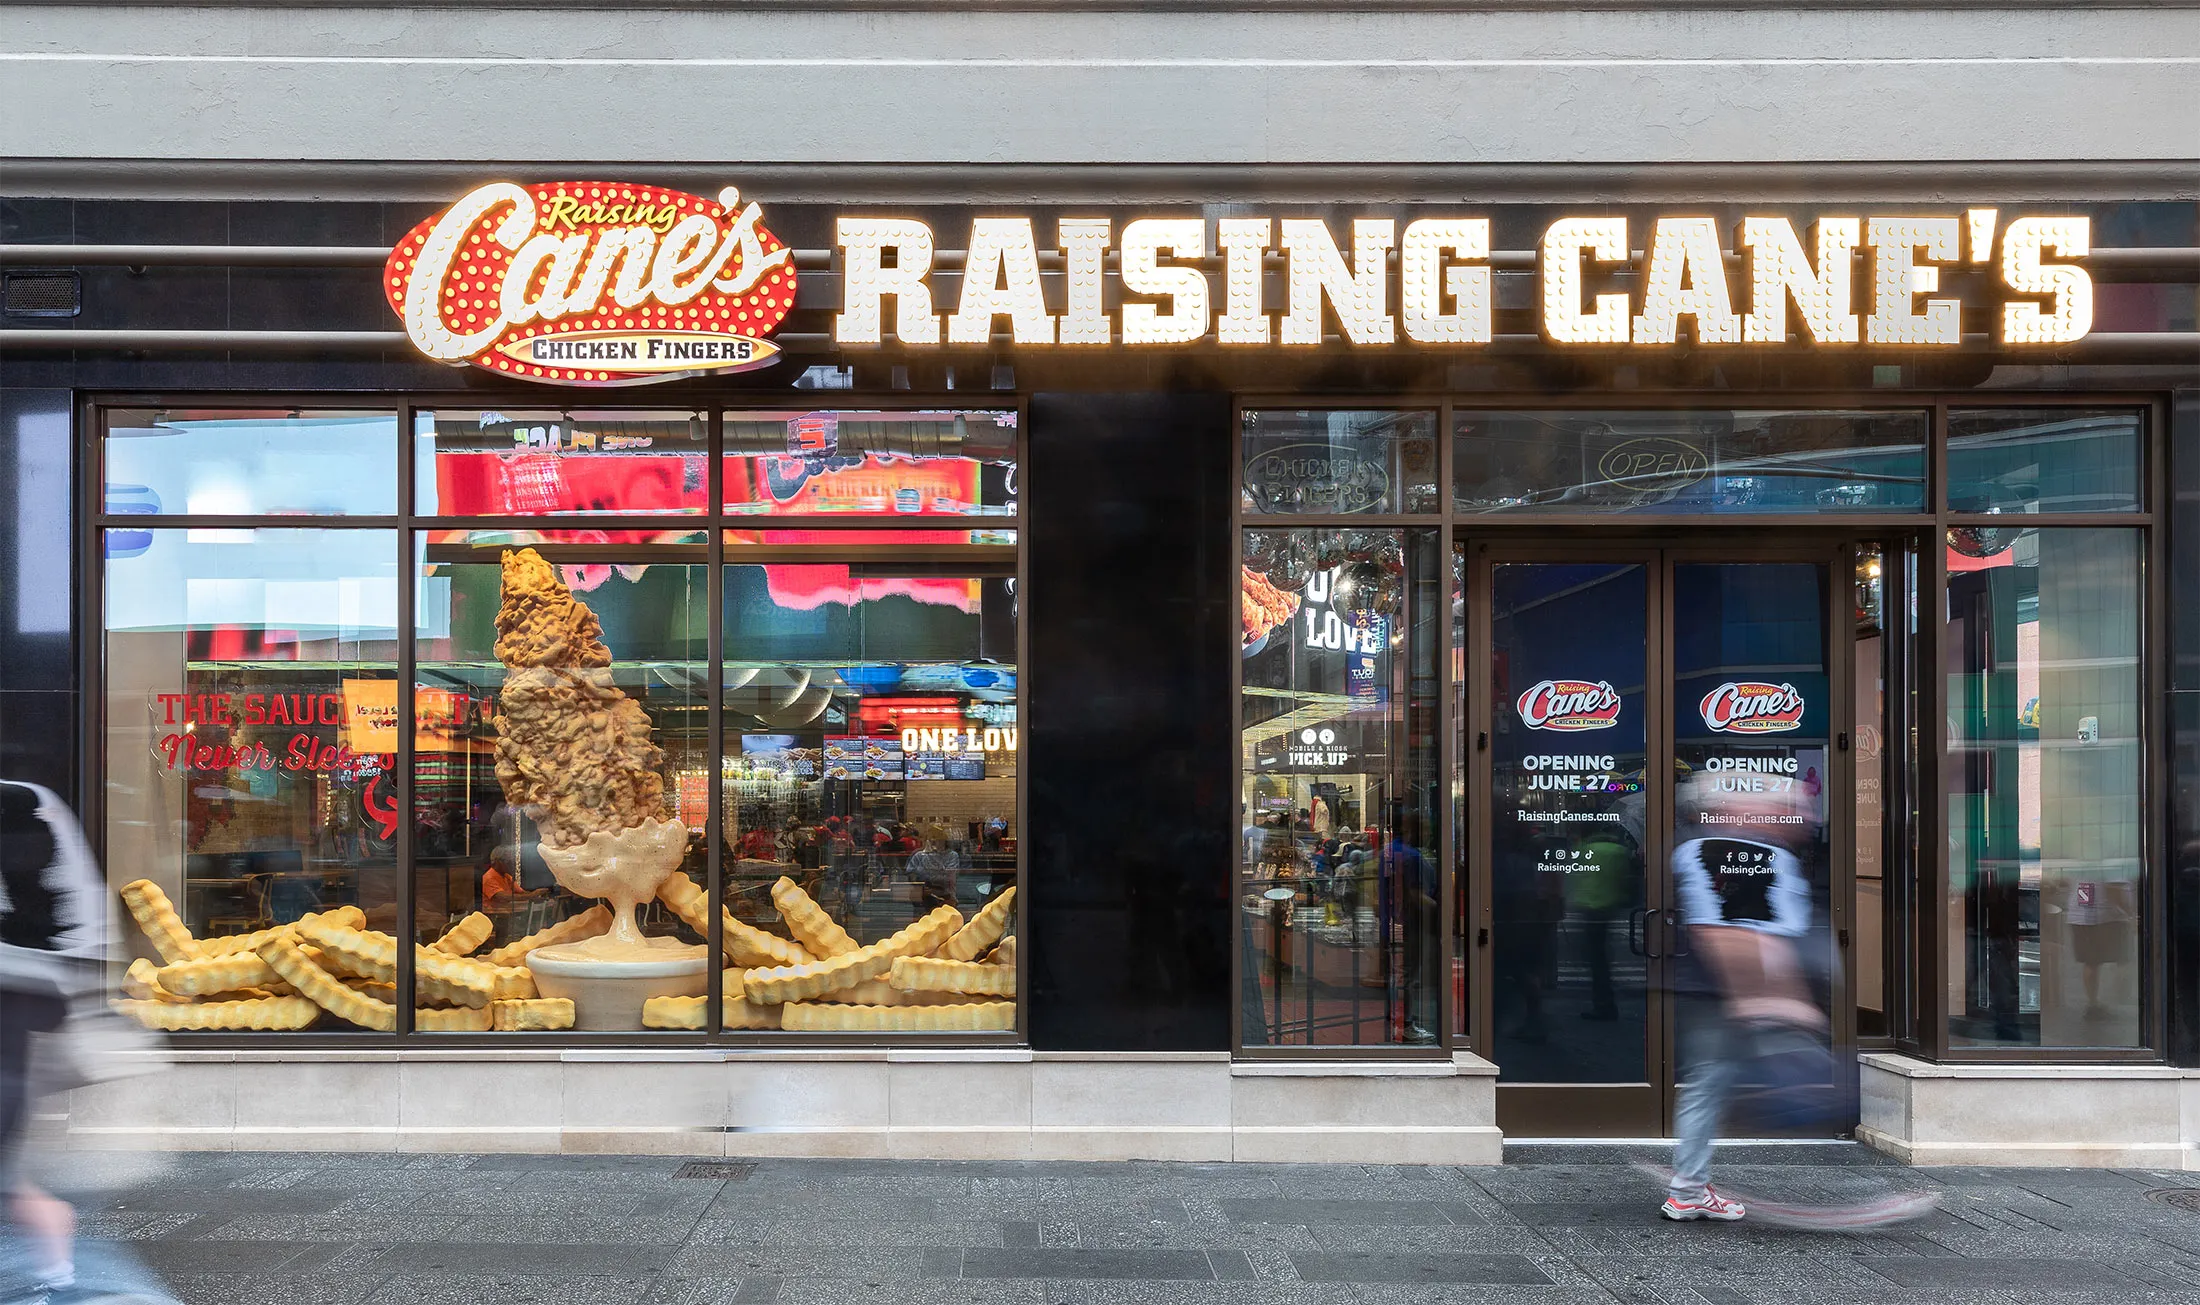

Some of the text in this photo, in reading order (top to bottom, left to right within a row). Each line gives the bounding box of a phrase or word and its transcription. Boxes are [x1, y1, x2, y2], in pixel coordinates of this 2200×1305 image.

[545, 195, 677, 233] Raising
[403, 181, 791, 360] Cane's
[836, 208, 2094, 344] RAISING CANE'S
[532, 338, 751, 360] CHICKEN FINGERS
[1266, 456, 1369, 479] CHICKEN
[1609, 452, 1697, 479] OPEN
[1266, 482, 1365, 503] FINGERS
[1305, 607, 1377, 654] LOVE
[1557, 684, 1590, 694] Raising
[1740, 686, 1773, 696] Raising
[157, 693, 232, 725] THE
[1523, 680, 1620, 726] Cane's
[1706, 682, 1803, 728] Cane's
[902, 728, 958, 752] ONE
[159, 733, 276, 771] Never
[1289, 752, 1348, 766] PICK UP
[1523, 755, 1615, 771] OPENING
[1705, 757, 1798, 773] OPENING
[1527, 775, 1610, 790] JUNE 27
[1711, 777, 1794, 793] JUNE 27
[1517, 810, 1620, 824] RaisingCanes.com
[1700, 812, 1803, 826] RaisingCanes.com
[1537, 863, 1600, 873] RaisingCanes
